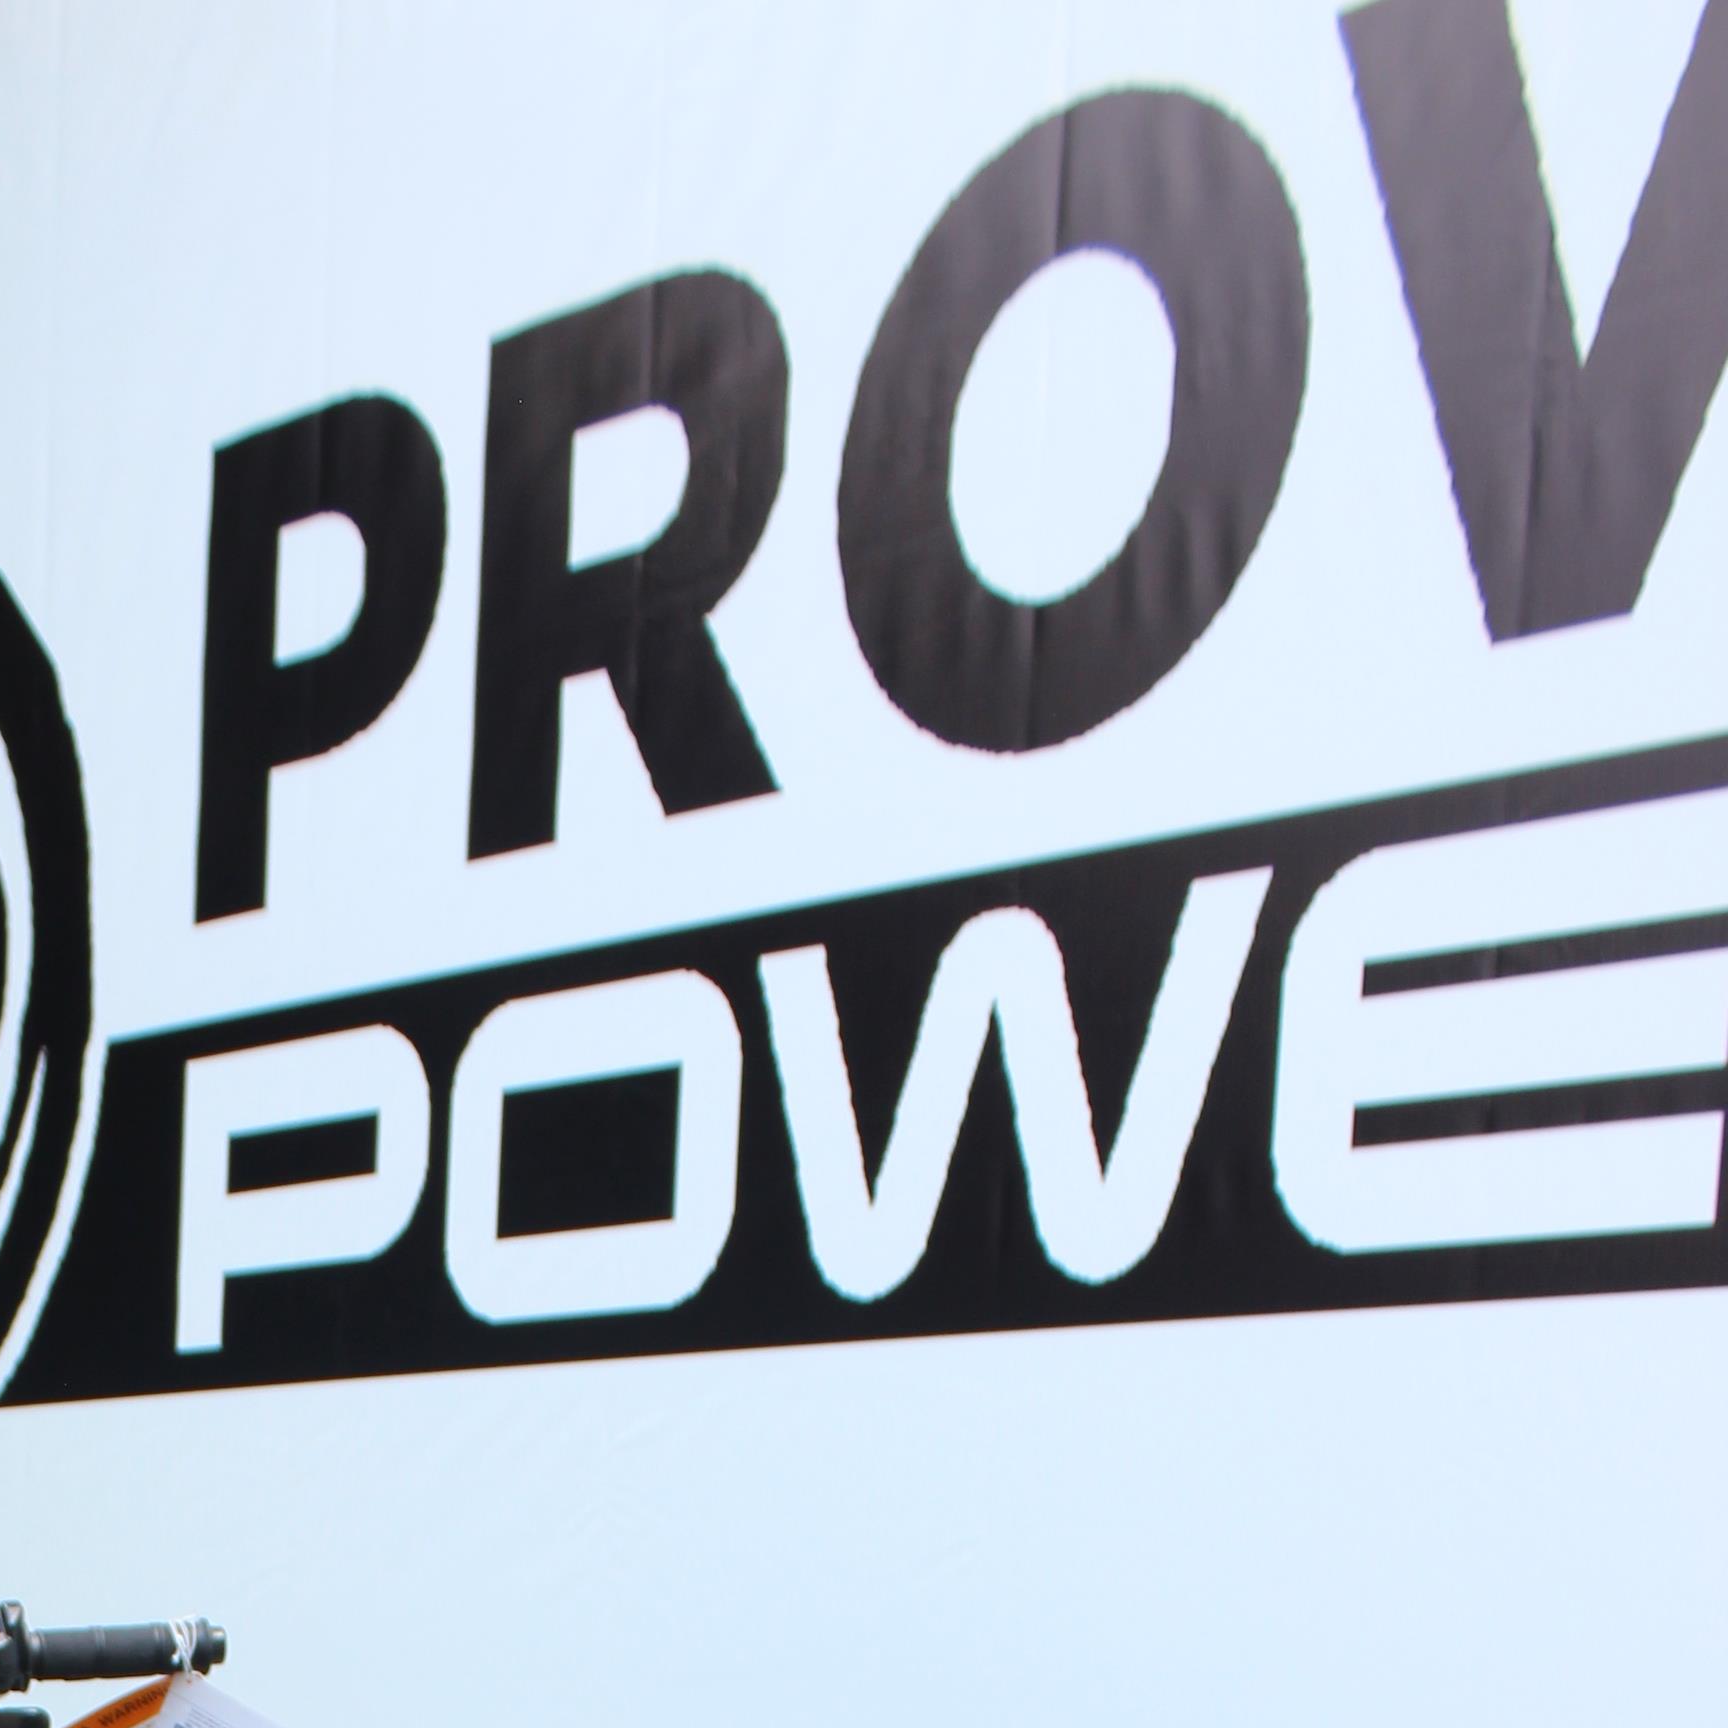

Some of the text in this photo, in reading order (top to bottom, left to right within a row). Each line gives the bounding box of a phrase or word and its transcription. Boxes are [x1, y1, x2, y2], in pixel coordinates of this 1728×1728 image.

[194, 0, 1728, 927] PROV
[176, 787, 1728, 1353] POWE
[98, 1687, 169, 1727] WARNIN
